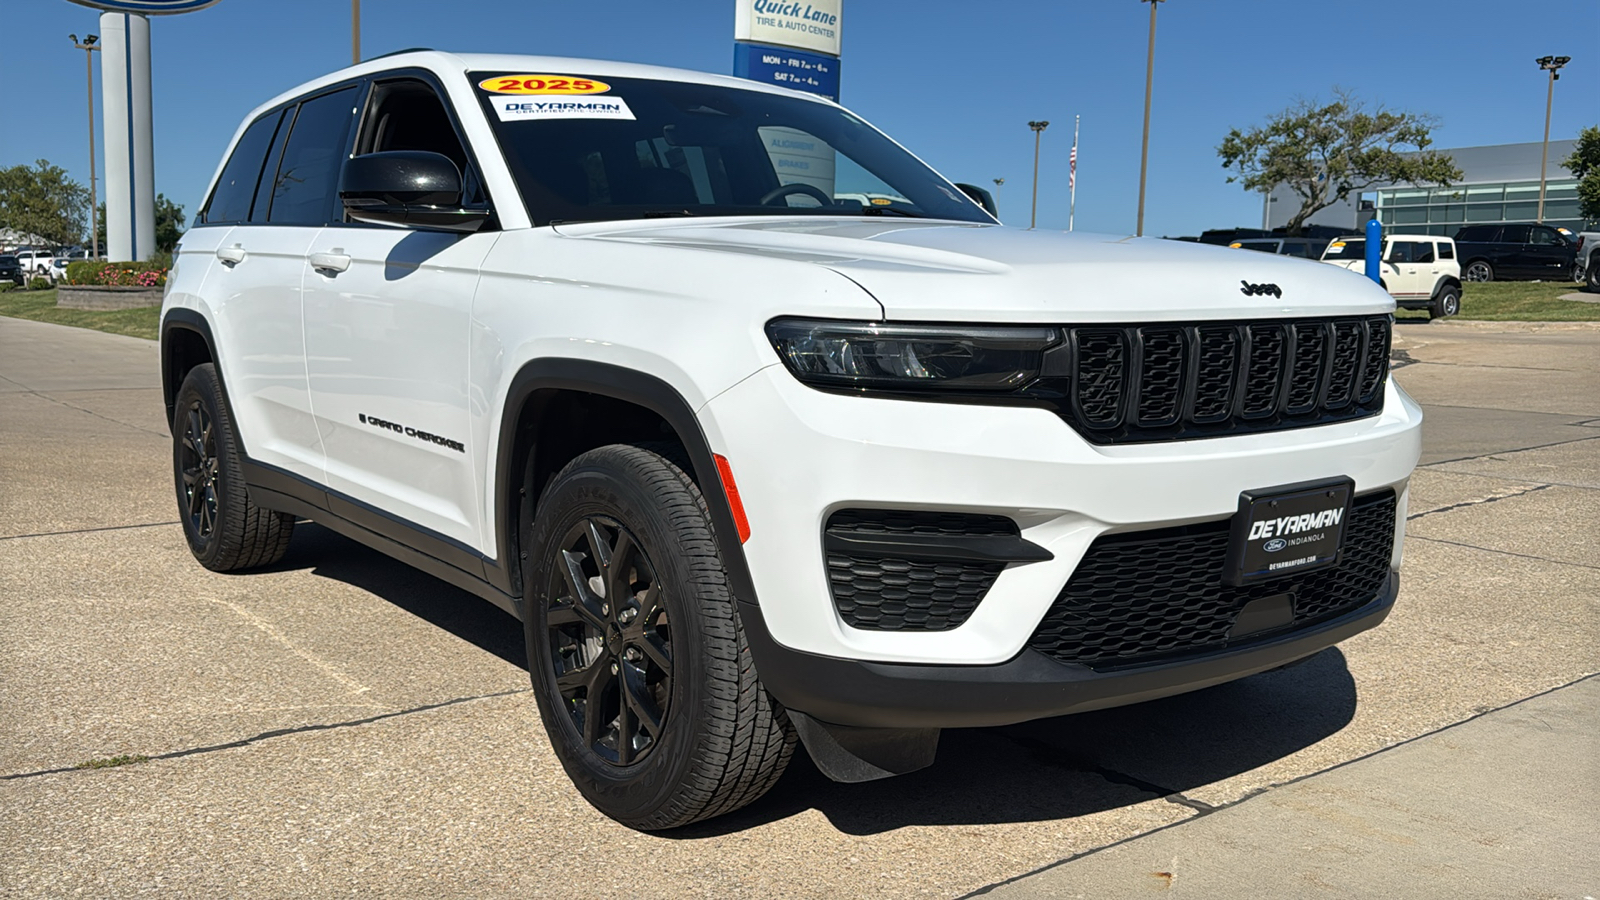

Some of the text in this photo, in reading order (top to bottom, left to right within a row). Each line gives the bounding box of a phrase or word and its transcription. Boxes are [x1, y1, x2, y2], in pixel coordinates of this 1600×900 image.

[754, 0, 837, 26] Quick Lane
[756, 16, 835, 39] TIRE & AUTO CENTER
[762, 55, 780, 65] MON
[788, 58, 800, 67] FRI
[774, 72, 788, 81] SAT
[498, 79, 595, 91] 2025
[505, 102, 620, 111] DEYARMAN
[778, 159, 809, 170] BRAKES
[1240, 280, 1282, 299] Jeep
[367, 416, 465, 453] GRAND CHEROKEE
[1248, 507, 1344, 540] DEYARMAN
[1288, 533, 1325, 546] INDIANOLA
[1269, 555, 1316, 570] DEYARMANFORD.COM
